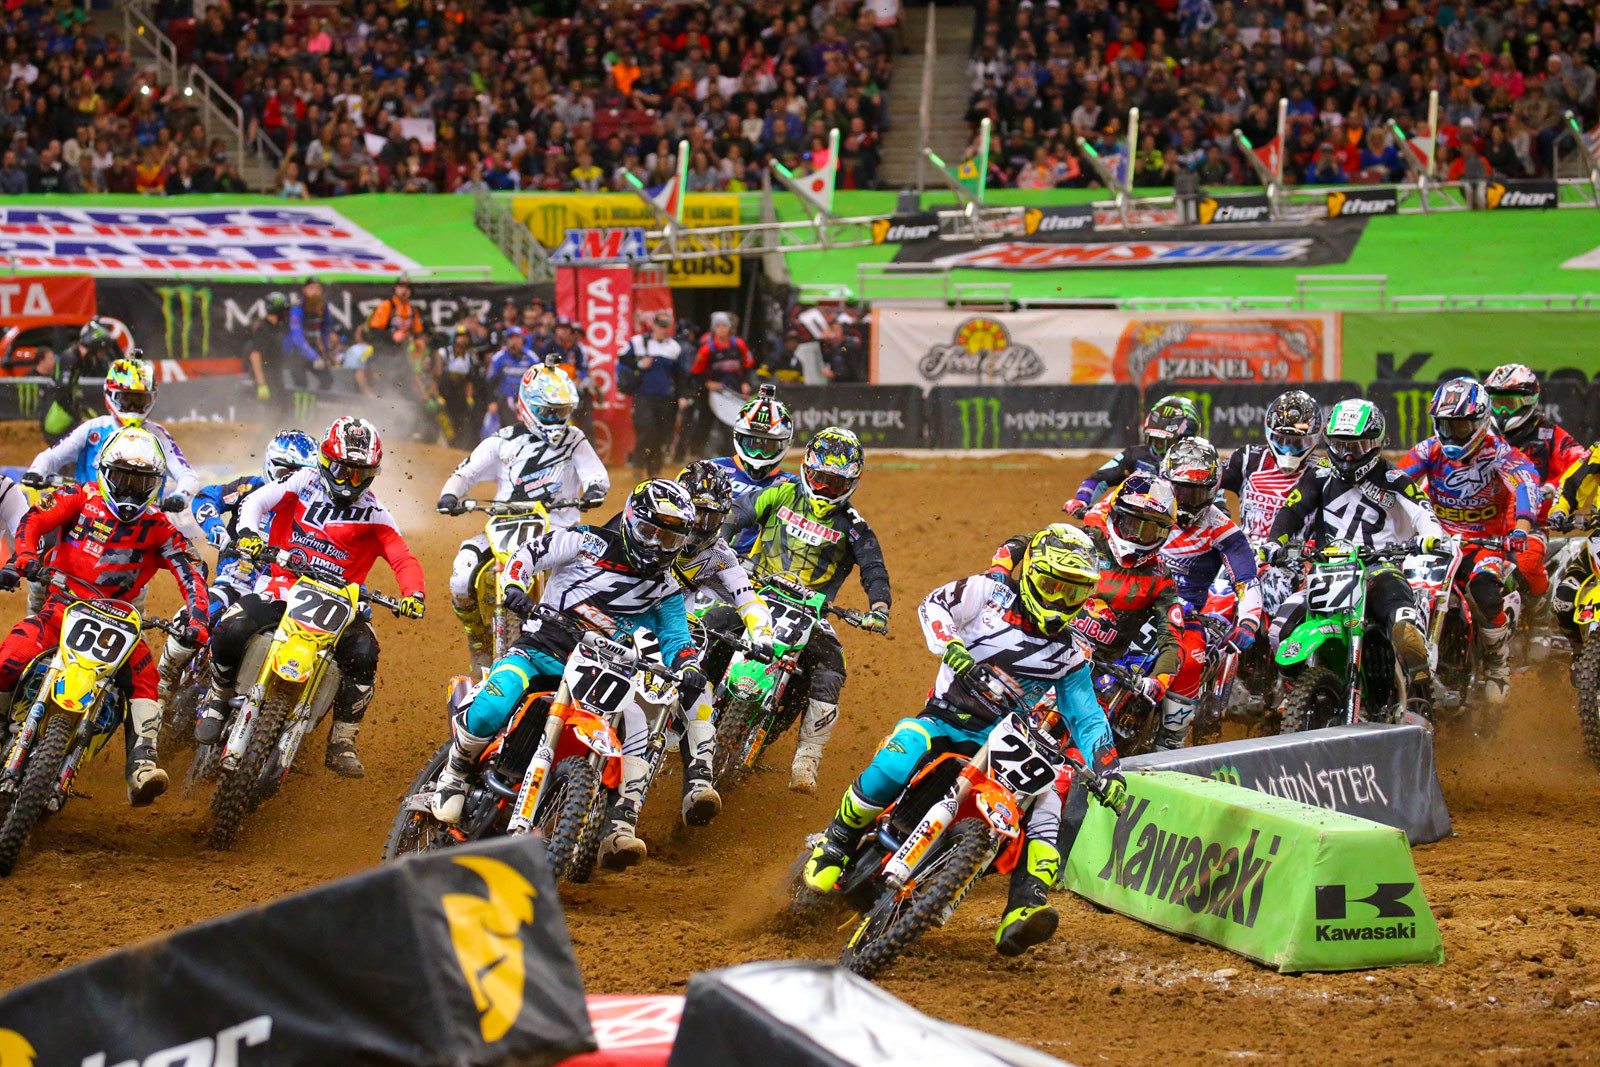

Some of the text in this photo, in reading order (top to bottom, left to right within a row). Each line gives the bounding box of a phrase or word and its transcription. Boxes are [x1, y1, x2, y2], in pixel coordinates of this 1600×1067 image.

[1340, 194, 1396, 215] thor
[1500, 189, 1556, 208] thor
[0, 210, 336, 227] ARTS
[886, 221, 939, 242] thor
[1040, 212, 1092, 233] thor
[548, 227, 648, 264] AMA
[1004, 409, 1113, 431] MONSTER
[1436, 494, 1490, 506] HONDA
[776, 505, 841, 544] DISCOUNT
[790, 525, 817, 544] TIRE
[288, 531, 325, 554] Soaring
[494, 522, 546, 556] 70
[310, 555, 347, 576] JIMMY
[1308, 574, 1361, 610] 27
[287, 589, 349, 632] 20
[65, 617, 127, 664] 69
[1068, 616, 1118, 646] ed Bull
[571, 664, 631, 712] 10
[990, 734, 1056, 795] 29
[1255, 761, 1388, 811] MONSTER
[1097, 795, 1281, 928] Kawasaki
[1315, 922, 1416, 941] Kawasaki
